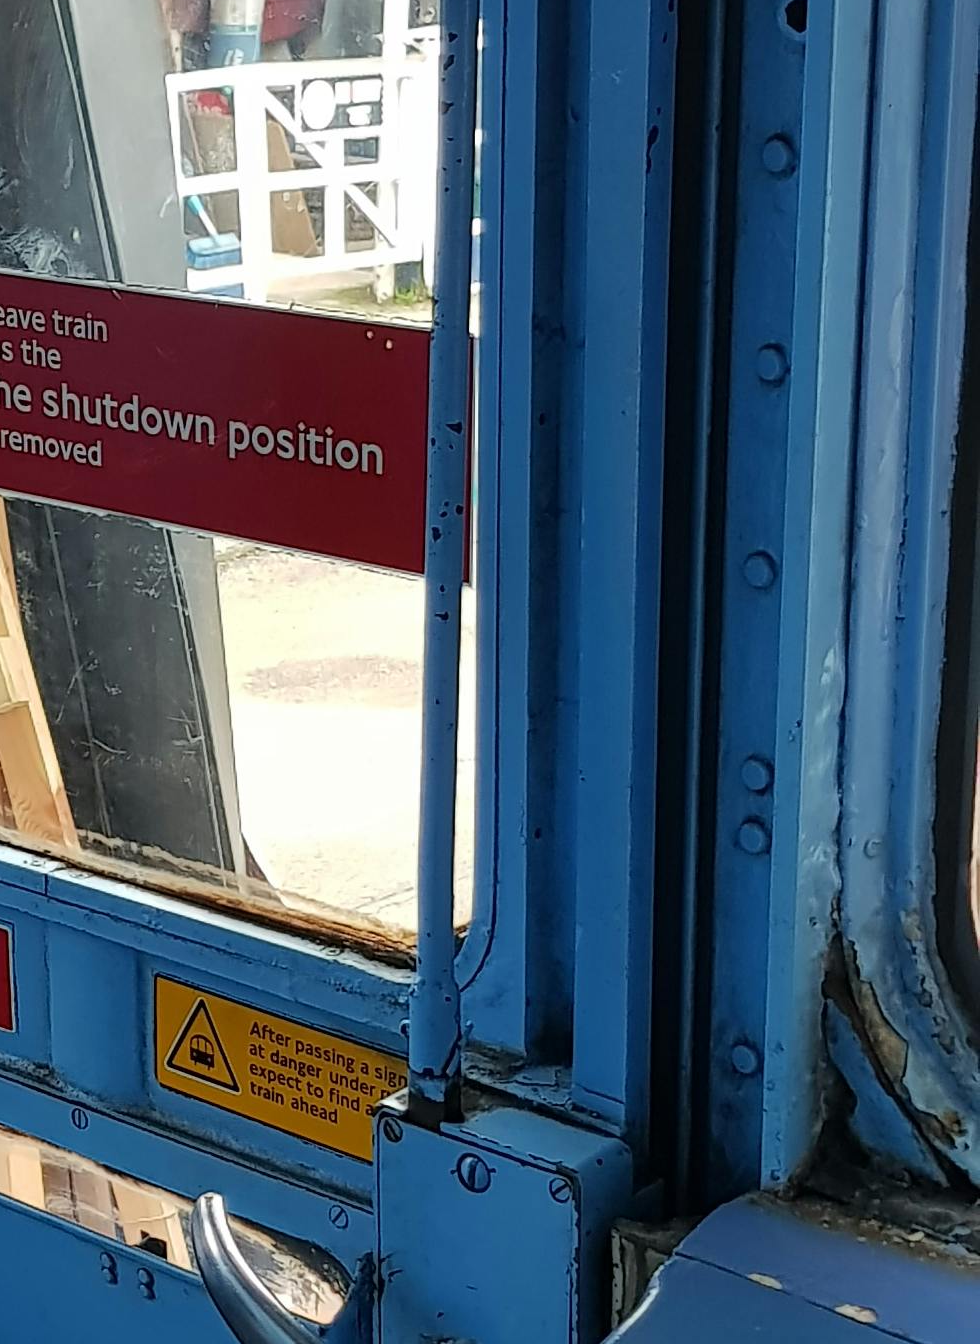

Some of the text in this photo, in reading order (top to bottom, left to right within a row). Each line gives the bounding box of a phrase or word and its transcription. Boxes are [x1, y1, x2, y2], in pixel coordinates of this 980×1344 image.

[51, 309, 109, 342] train
[20, 340, 62, 370] the
[0, 428, 103, 467] removed
[42, 383, 215, 445] shutdown
[227, 421, 384, 476] position
[249, 1021, 291, 1048] After
[295, 1039, 355, 1074] passing
[360, 1062, 369, 1075] a
[249, 1043, 266, 1059] at
[270, 1049, 322, 1078] danger
[329, 1072, 376, 1097] under
[249, 1063, 374, 1116] expect to find a
[250, 1081, 338, 1124] train ahead
